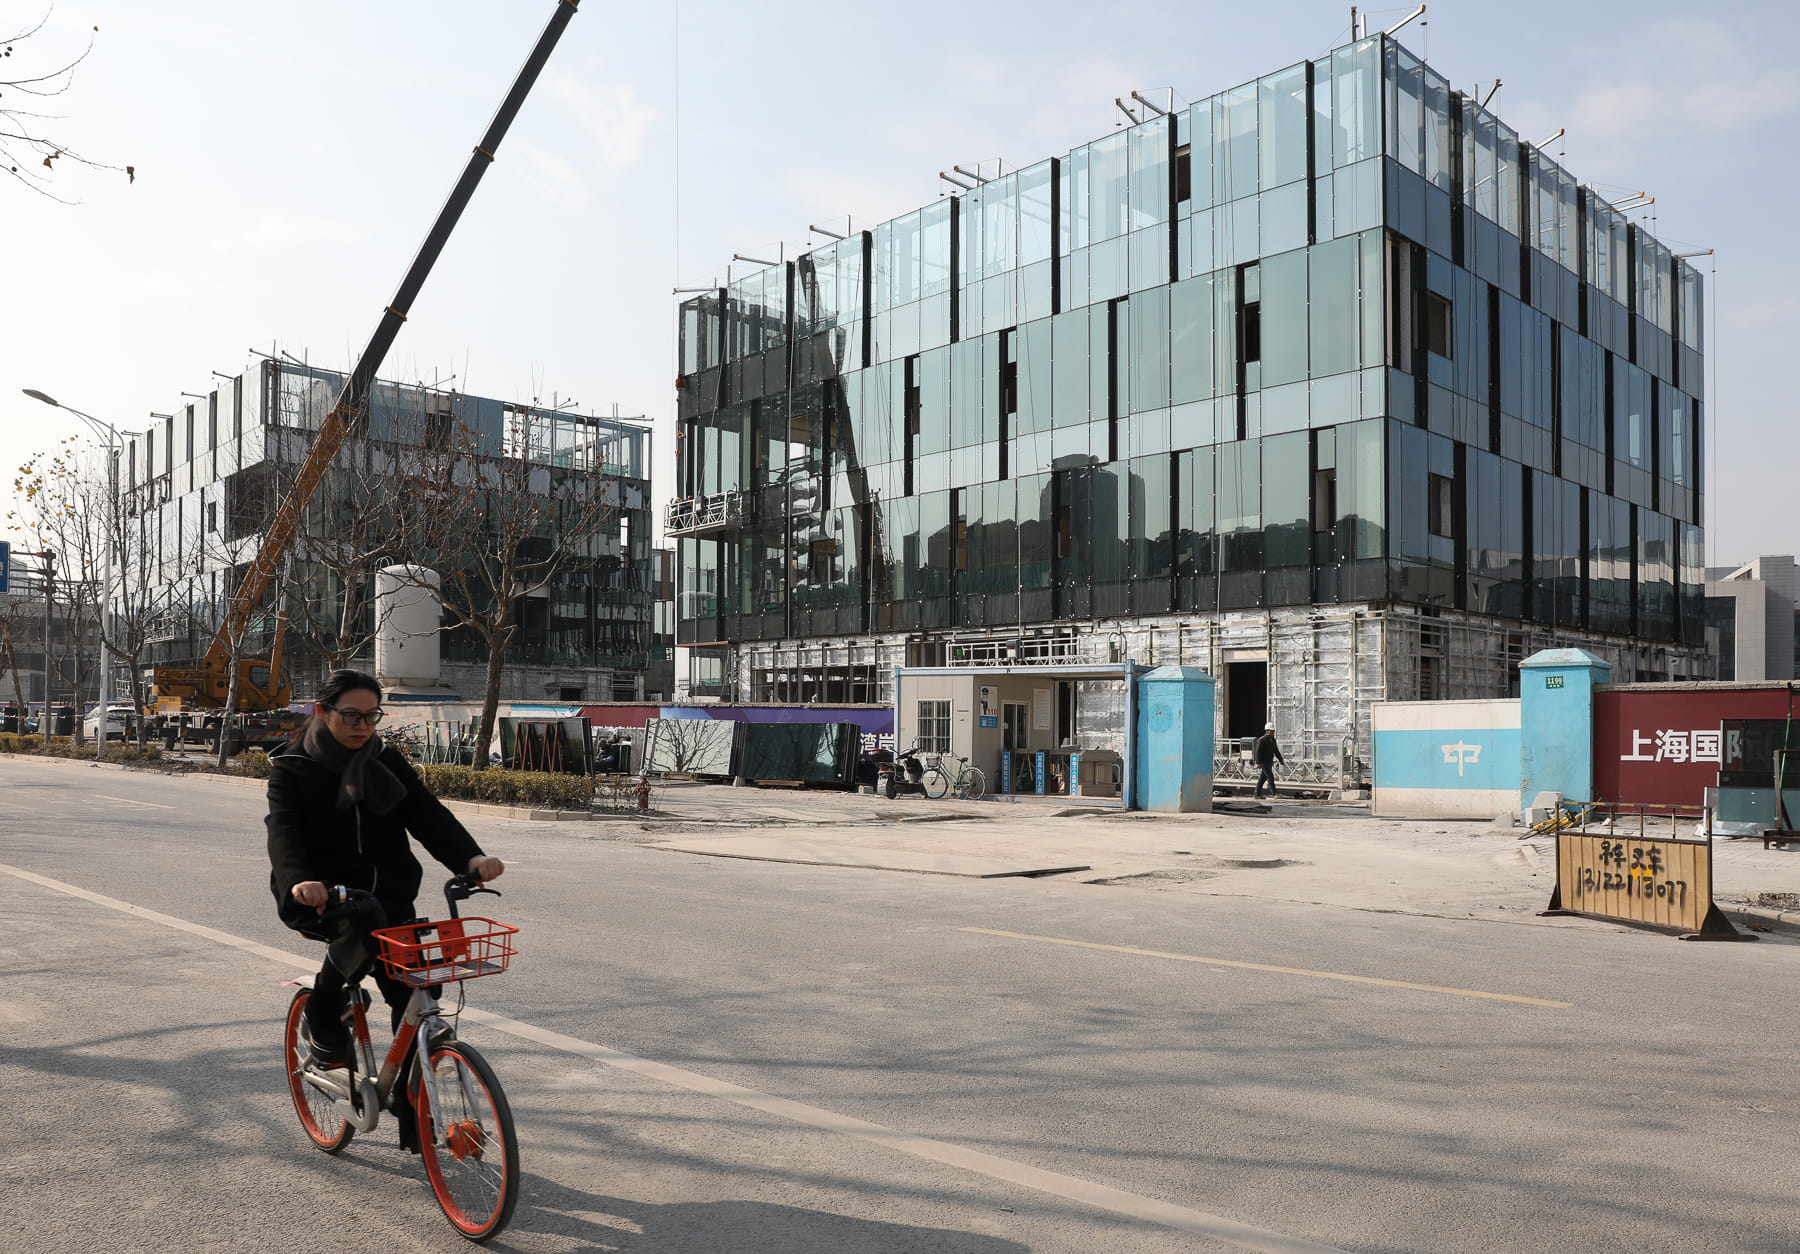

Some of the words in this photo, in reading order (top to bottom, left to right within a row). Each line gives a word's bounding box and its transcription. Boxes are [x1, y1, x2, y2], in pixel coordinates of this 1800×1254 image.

[1547, 677, 1562, 685] 1199
[1440, 739, 1482, 777] 中
[1577, 866, 1687, 909] 13122113077
